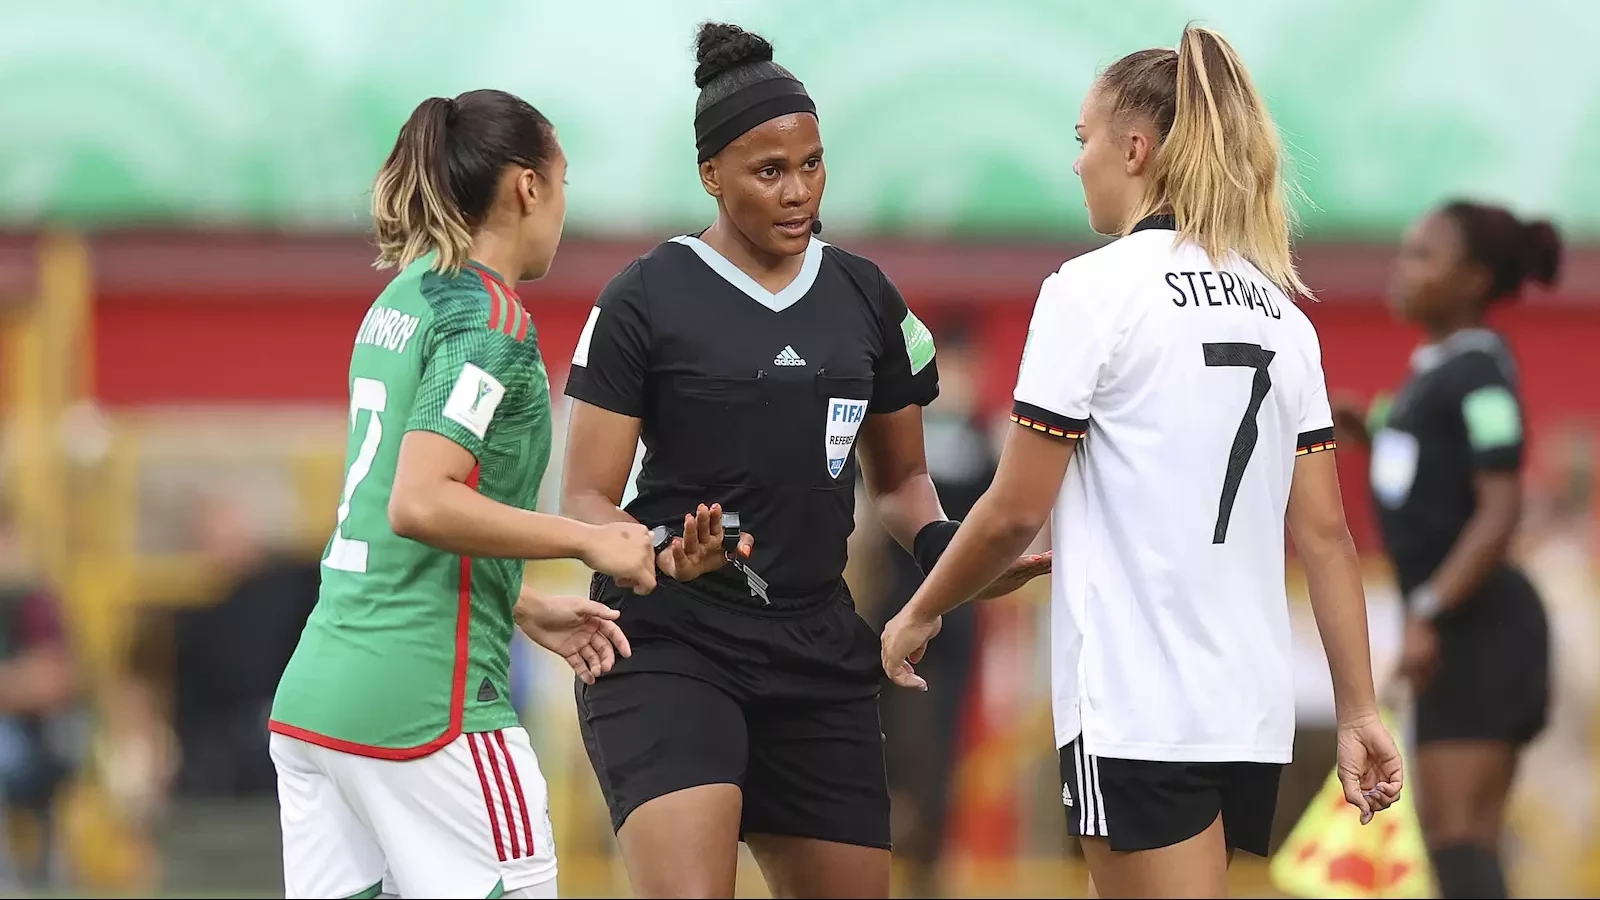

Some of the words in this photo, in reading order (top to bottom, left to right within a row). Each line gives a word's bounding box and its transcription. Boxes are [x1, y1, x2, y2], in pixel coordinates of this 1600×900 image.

[1164, 270, 1281, 320] STERNAD
[774, 357, 807, 366] adidas
[832, 403, 863, 422] FIFA
[1202, 342, 1276, 544] 7
[321, 376, 387, 573] 2
